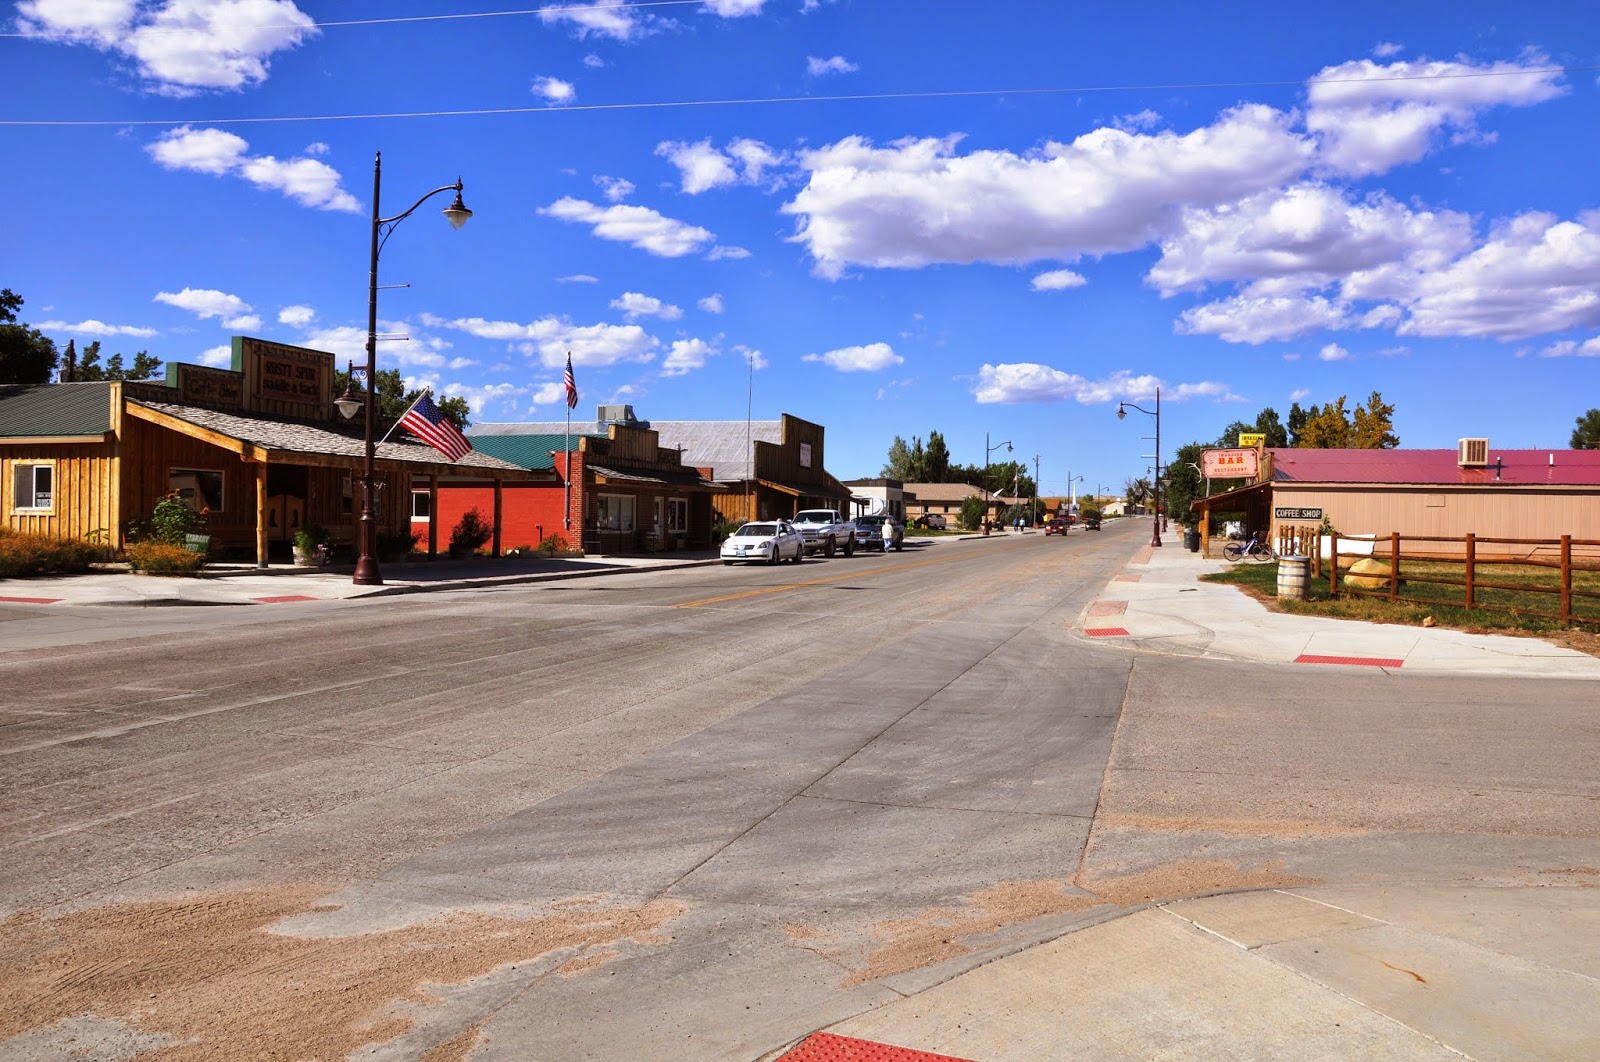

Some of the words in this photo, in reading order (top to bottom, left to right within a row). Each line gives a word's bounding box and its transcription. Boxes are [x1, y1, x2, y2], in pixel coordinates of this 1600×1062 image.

[1218, 456, 1244, 465] BAR
[1276, 509, 1300, 518] COFFEE
[1301, 509, 1321, 518] SHOP
[185, 533, 210, 543] LIBRARY
